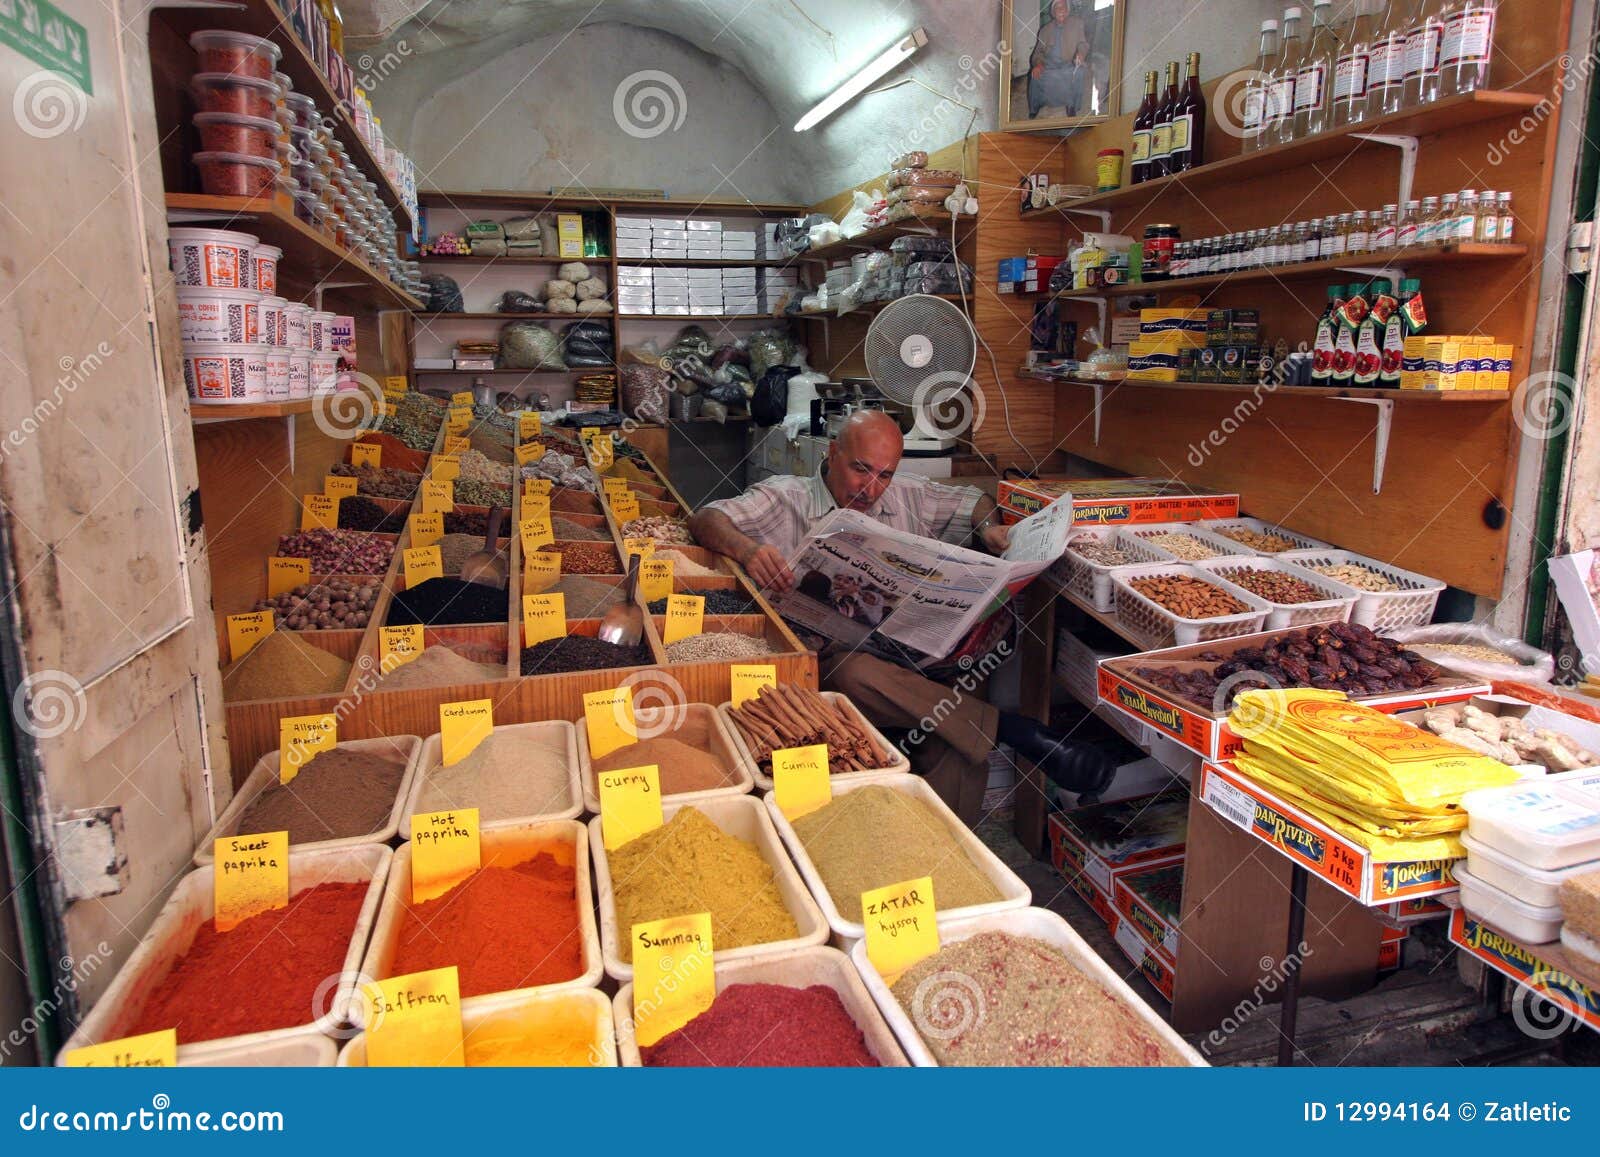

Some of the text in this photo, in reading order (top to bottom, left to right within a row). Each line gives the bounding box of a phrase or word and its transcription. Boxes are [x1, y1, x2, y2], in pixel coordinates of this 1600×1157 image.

[1072, 505, 1126, 524] JORDAN RIVER
[643, 561, 668, 570] Green
[645, 572, 669, 581] pepper
[1121, 689, 1180, 728] JORDAN RIVER
[430, 816, 456, 826] Hot
[231, 839, 270, 852] Sweet
[416, 829, 470, 845] paprika
[1273, 818, 1316, 857] RIVER
[223, 857, 278, 875] paprika
[1332, 846, 1356, 871] 5 kg
[1329, 863, 1341, 878] 11
[1386, 859, 1441, 895] JORDAN
[866, 891, 925, 916] ZATAR
[1466, 924, 1598, 1009] JORDAN RIVER
[372, 991, 450, 1016] Saffran
